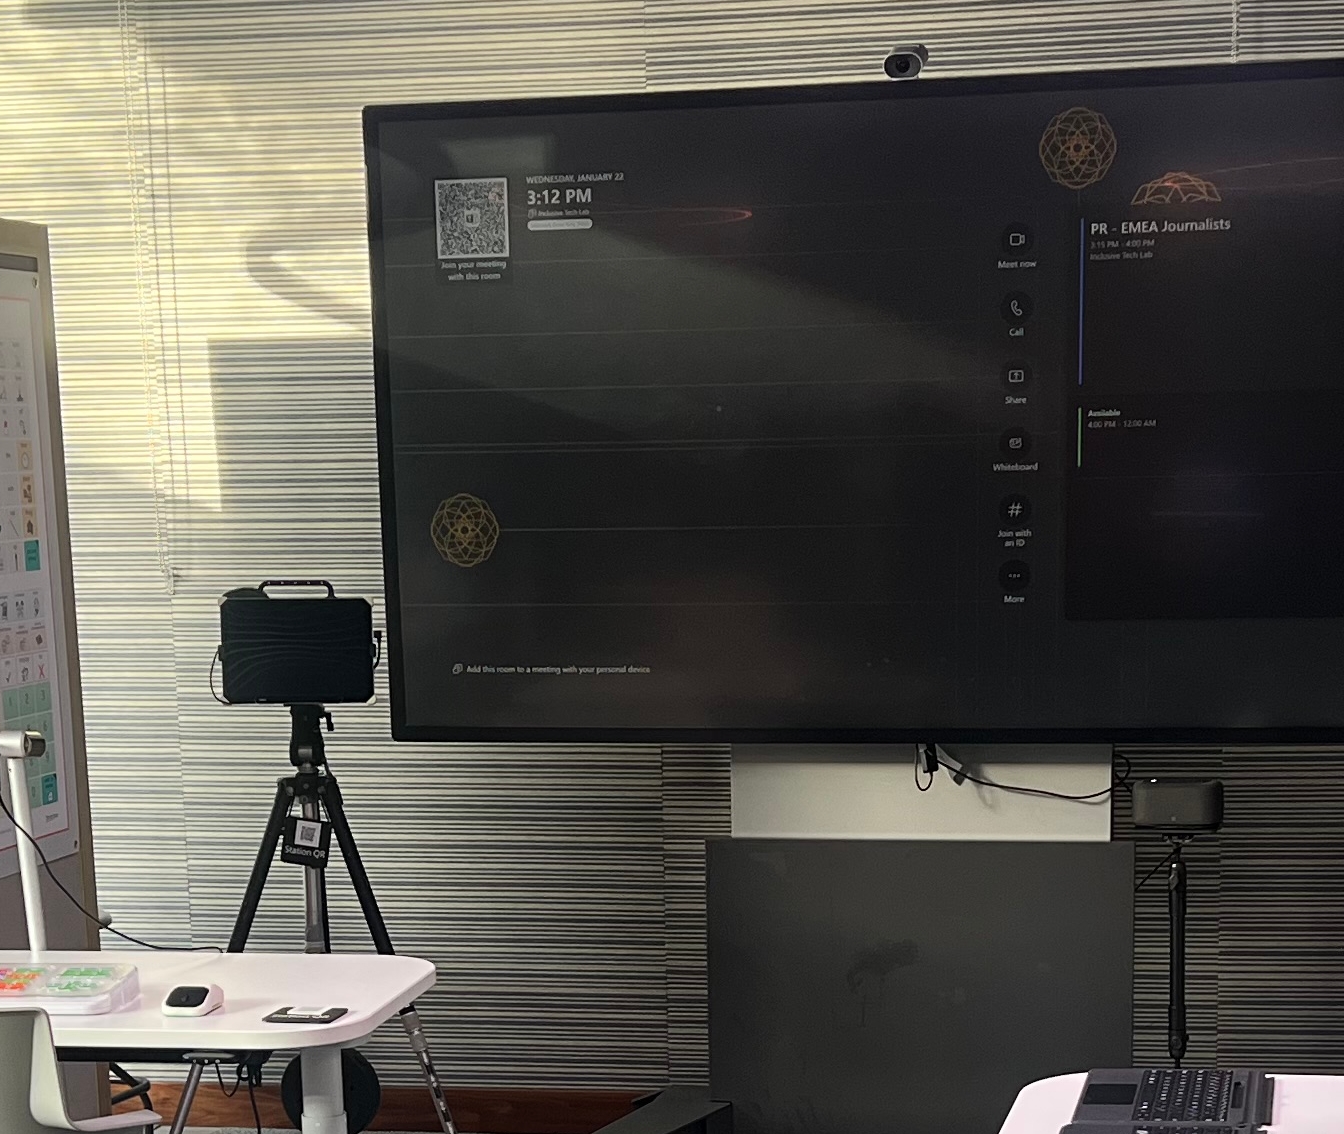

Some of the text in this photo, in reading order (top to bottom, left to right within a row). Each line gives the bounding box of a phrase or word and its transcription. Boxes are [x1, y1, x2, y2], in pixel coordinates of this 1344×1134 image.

[526, 173, 624, 184] WEDNESDAY, JANUARY 22
[527, 188, 591, 205] 3:12 PM
[1091, 223, 1108, 235] PR
[1121, 222, 1158, 234] EMEA
[1161, 218, 1231, 232] Journalists
[998, 260, 1036, 269] Meet now
[1009, 328, 1024, 336] Call
[1005, 396, 1027, 404] Share
[993, 462, 1038, 472] Whiteboard
[1015, 529, 1032, 537] with
[467, 665, 480, 673] Add
[532, 666, 561, 674] meeting
[596, 665, 626, 674] personal
[628, 665, 650, 673] device
[285, 845, 325, 859] Station QR
